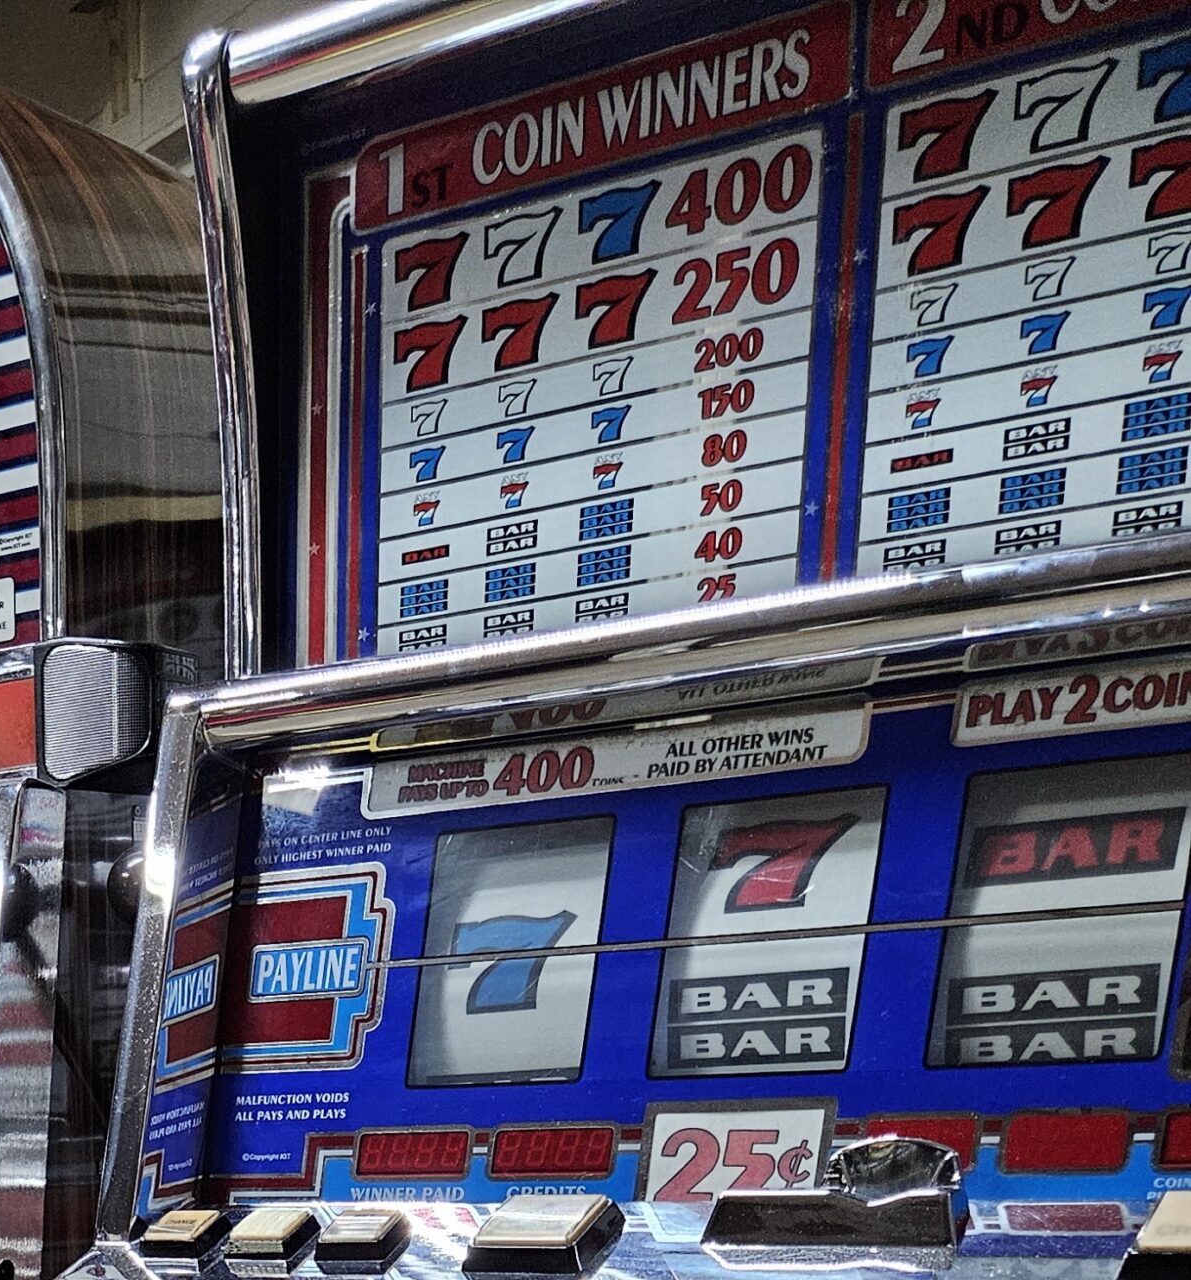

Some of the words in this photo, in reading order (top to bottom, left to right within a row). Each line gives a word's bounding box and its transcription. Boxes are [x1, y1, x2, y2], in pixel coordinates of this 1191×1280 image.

[472, 94, 586, 185] COIN
[596, 28, 811, 150] WINNERS
[666, 143, 813, 237] 400
[671, 236, 801, 326] 250
[693, 326, 764, 374] 200
[698, 378, 755, 420] 150
[701, 428, 748, 468] 80
[700, 478, 744, 517] 50
[694, 526, 743, 564] 40
[964, 685, 1063, 729] PLAY
[1063, 673, 1101, 725] 2
[646, 757, 689, 780] PAID
[693, 756, 716, 775] BY
[716, 744, 829, 774] ATTENDANT
[665, 737, 698, 759] ALL
[701, 731, 763, 755] OTHER
[766, 725, 815, 752] WINS
[408, 760, 485, 781] MACHINE
[492, 744, 595, 797] 400
[281, 849, 322, 865] HIGHEST
[324, 845, 365, 861] WINNER
[366, 842, 392, 856] PAID
[302, 831, 338, 847] CENTER
[341, 829, 364, 842] LINE
[366, 826, 392, 841] ONLY
[257, 946, 359, 995] PAYLINE
[679, 976, 835, 1016] BAR
[962, 974, 1142, 1016] BAR
[679, 1026, 832, 1061] BAR
[960, 1026, 1136, 1063] BAR
[235, 1092, 313, 1107] MALFUNCTION
[317, 1091, 350, 1104] VOIDS
[235, 1110, 254, 1123] ALL
[257, 1109, 283, 1122] PAYS
[285, 1108, 310, 1121] AND
[313, 1107, 347, 1121] PLAYS
[654, 1127, 813, 1202] 25¢
[350, 1186, 417, 1201] WINNER
[421, 1185, 465, 1201] PAID
